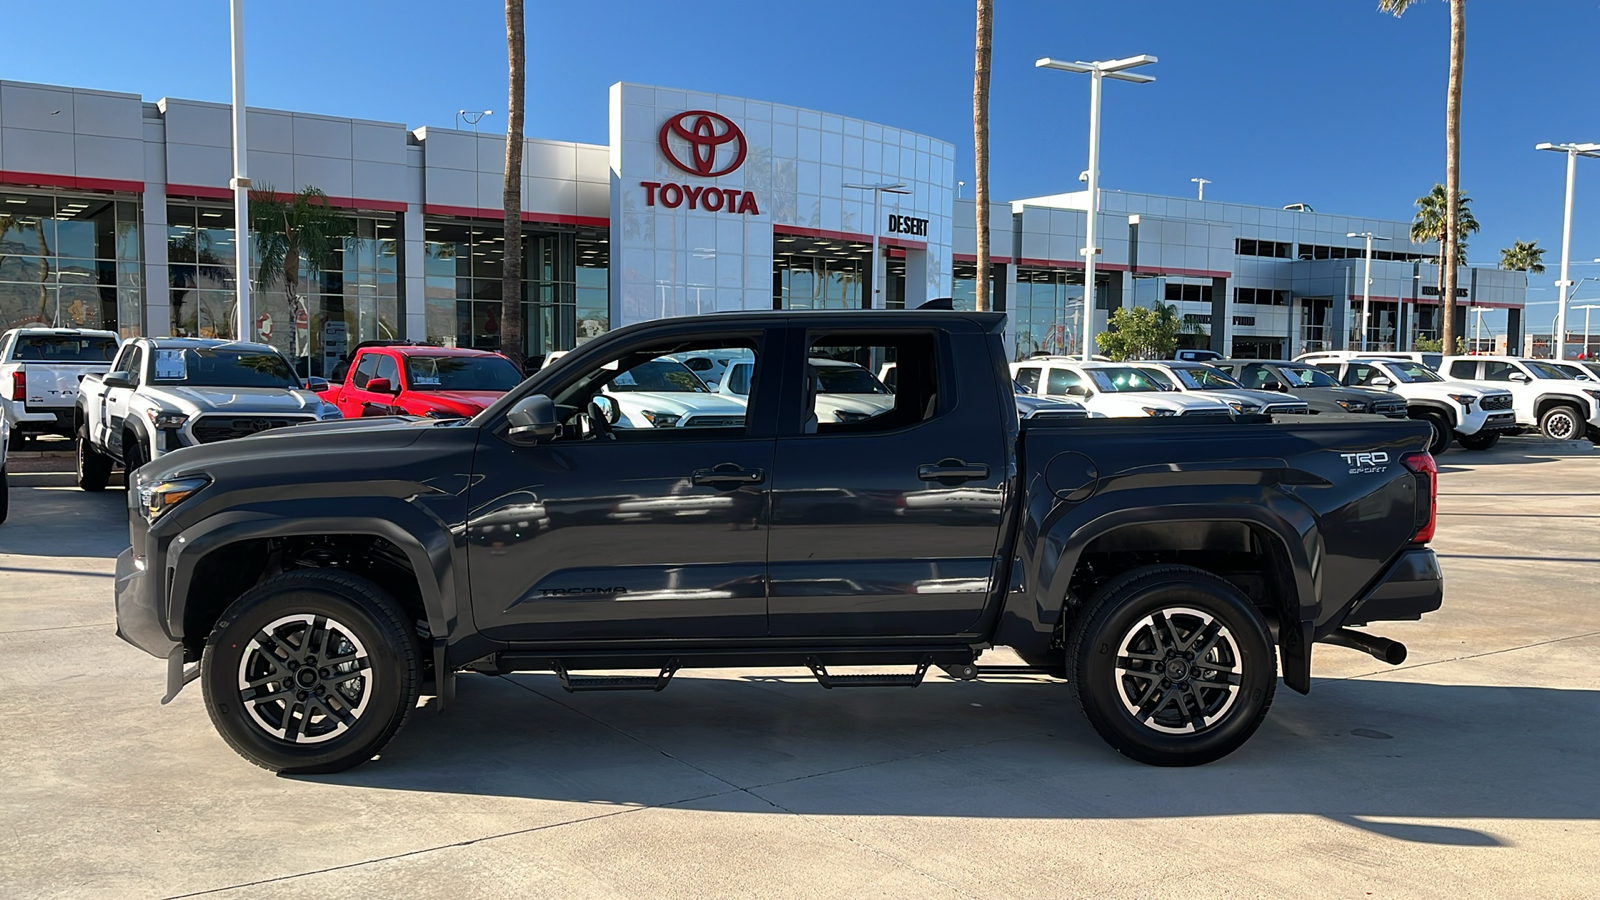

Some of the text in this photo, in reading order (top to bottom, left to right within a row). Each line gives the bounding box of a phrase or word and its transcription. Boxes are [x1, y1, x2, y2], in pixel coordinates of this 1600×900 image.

[640, 181, 759, 215] TOYOTA
[888, 214, 929, 236] DESERT
[1340, 452, 1389, 467] TRD
[1348, 466, 1387, 474] SPORT
[538, 586, 627, 596] TACOMA
